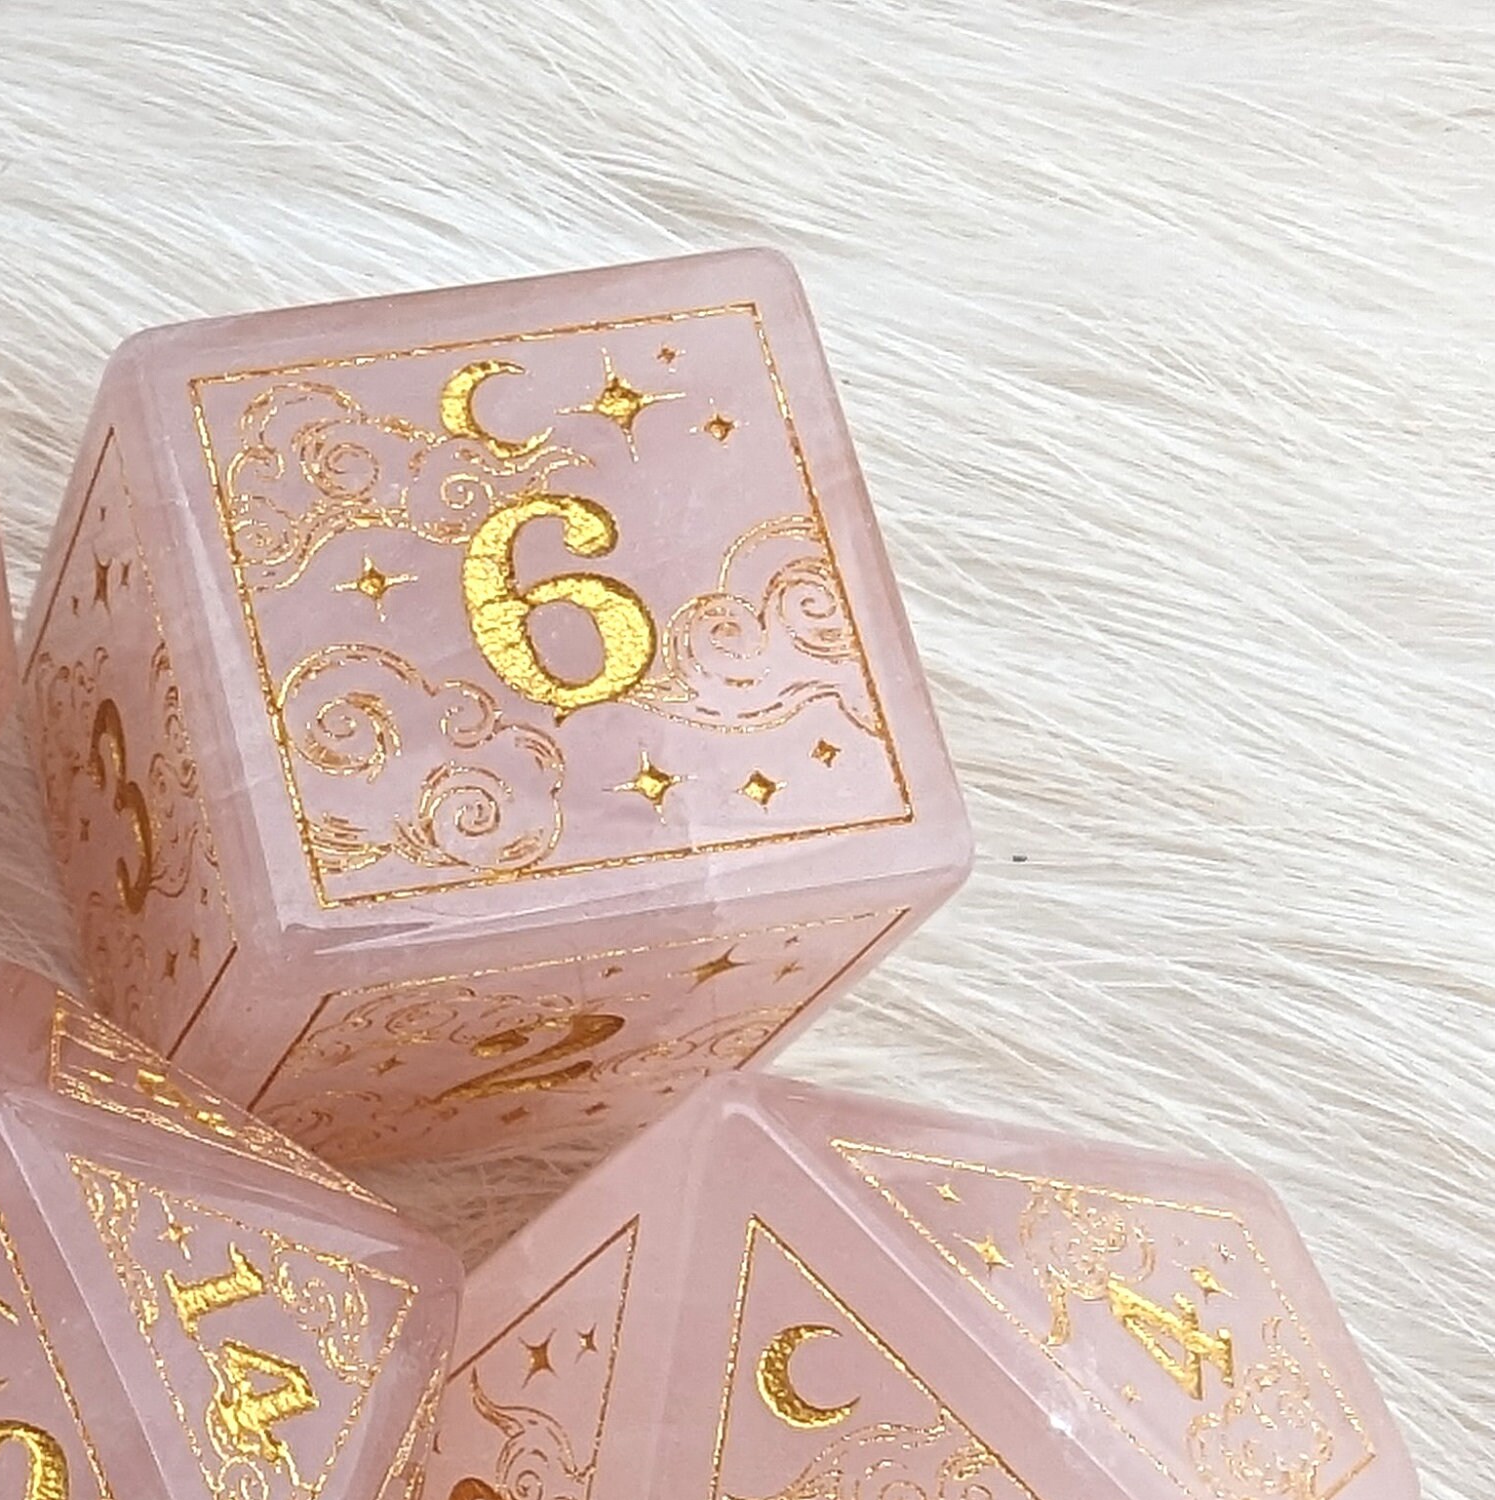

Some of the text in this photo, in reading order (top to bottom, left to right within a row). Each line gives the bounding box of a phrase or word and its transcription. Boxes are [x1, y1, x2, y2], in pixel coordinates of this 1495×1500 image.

[461, 493, 657, 714] 6
[87, 698, 152, 914] 3
[164, 1241, 321, 1462] 14
[1106, 1272, 1234, 1400] 4
